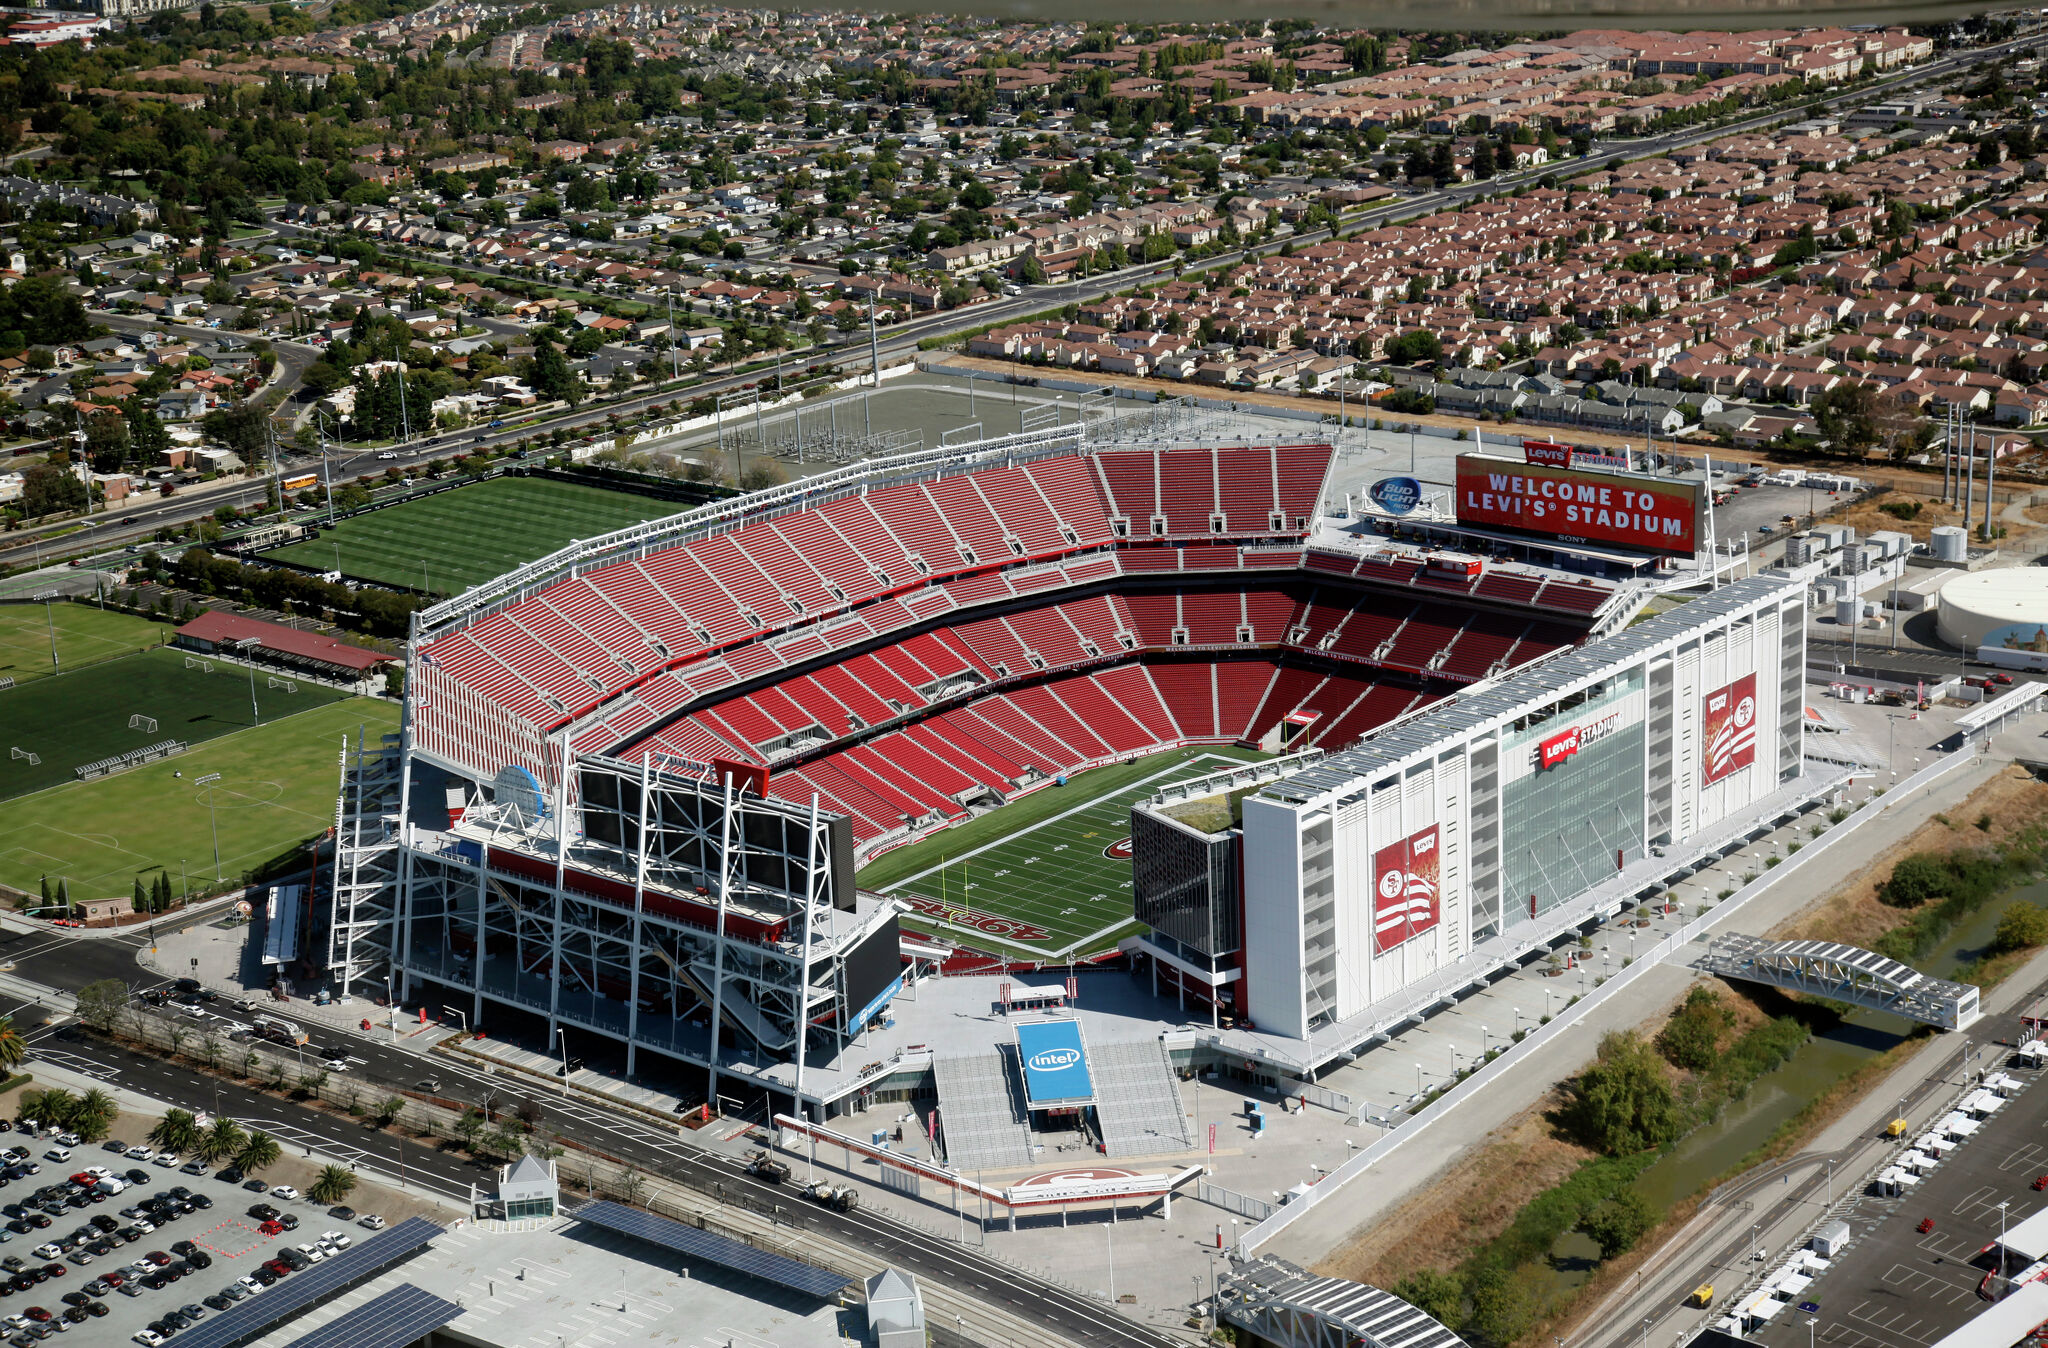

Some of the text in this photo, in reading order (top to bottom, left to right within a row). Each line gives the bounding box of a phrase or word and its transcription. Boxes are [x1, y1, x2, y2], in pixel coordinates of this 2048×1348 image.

[1573, 452, 1628, 468] STADIUM
[1384, 483, 1413, 495] BUD
[1489, 473, 1655, 511] WELCOME TO
[1377, 490, 1418, 504] LIGHT
[1566, 505, 1682, 536] STADIUM
[1558, 534, 1587, 544] SONY
[1580, 713, 1620, 741] STADIUM
[1035, 1052, 1072, 1066] intel
